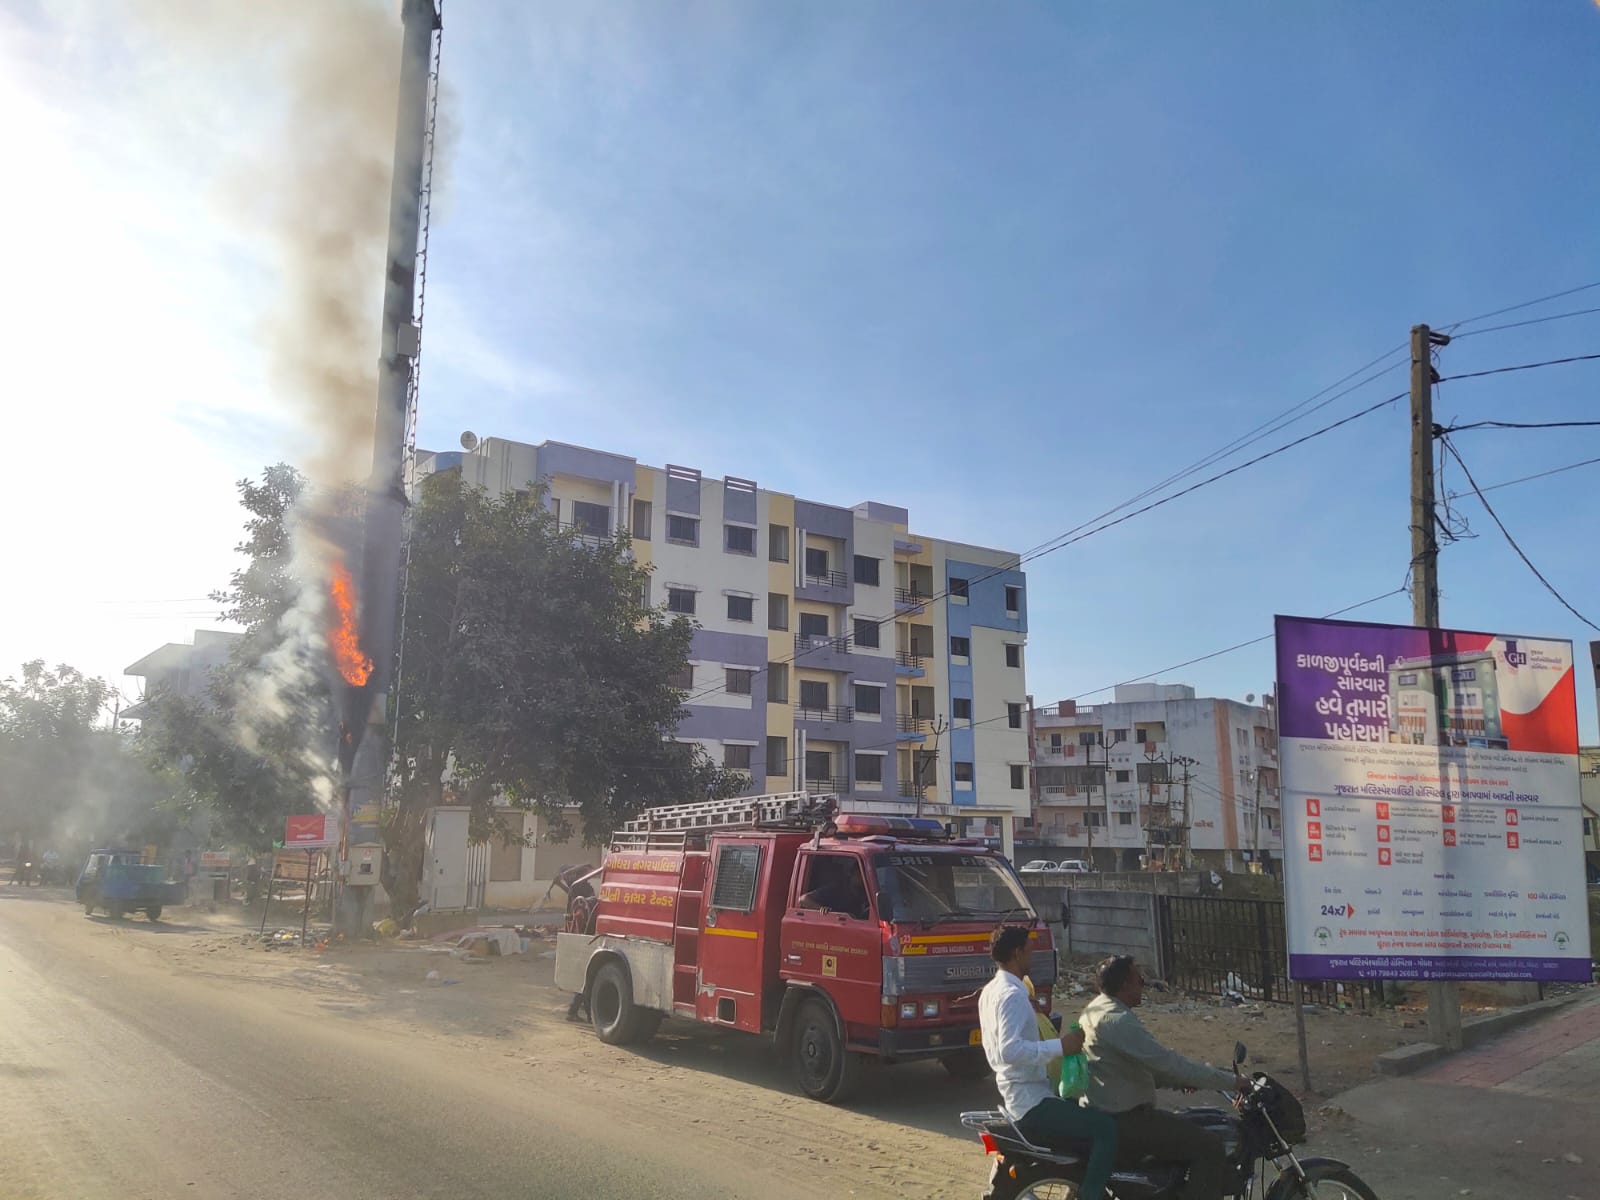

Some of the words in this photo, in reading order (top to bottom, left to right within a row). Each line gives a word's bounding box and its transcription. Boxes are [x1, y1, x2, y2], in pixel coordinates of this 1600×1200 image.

[1296, 652, 1385, 676] કાળજીપૂર્વકની
[1508, 653, 1526, 665] GH
[1337, 676, 1386, 693] સારવાર
[1315, 689, 1343, 716] હવે
[1346, 694, 1392, 720] તમારી
[1324, 715, 1389, 742] પહોંચમાં
[1333, 784, 1359, 796] ગુજરાત
[1461, 789, 1491, 801] આપવામાં
[1492, 790, 1515, 801] આવતી
[1516, 793, 1540, 803] સારવાર
[623, 891, 647, 904] ફાયર
[650, 890, 674, 907] ટેન્ડર
[1321, 904, 1346, 917] 24x7
